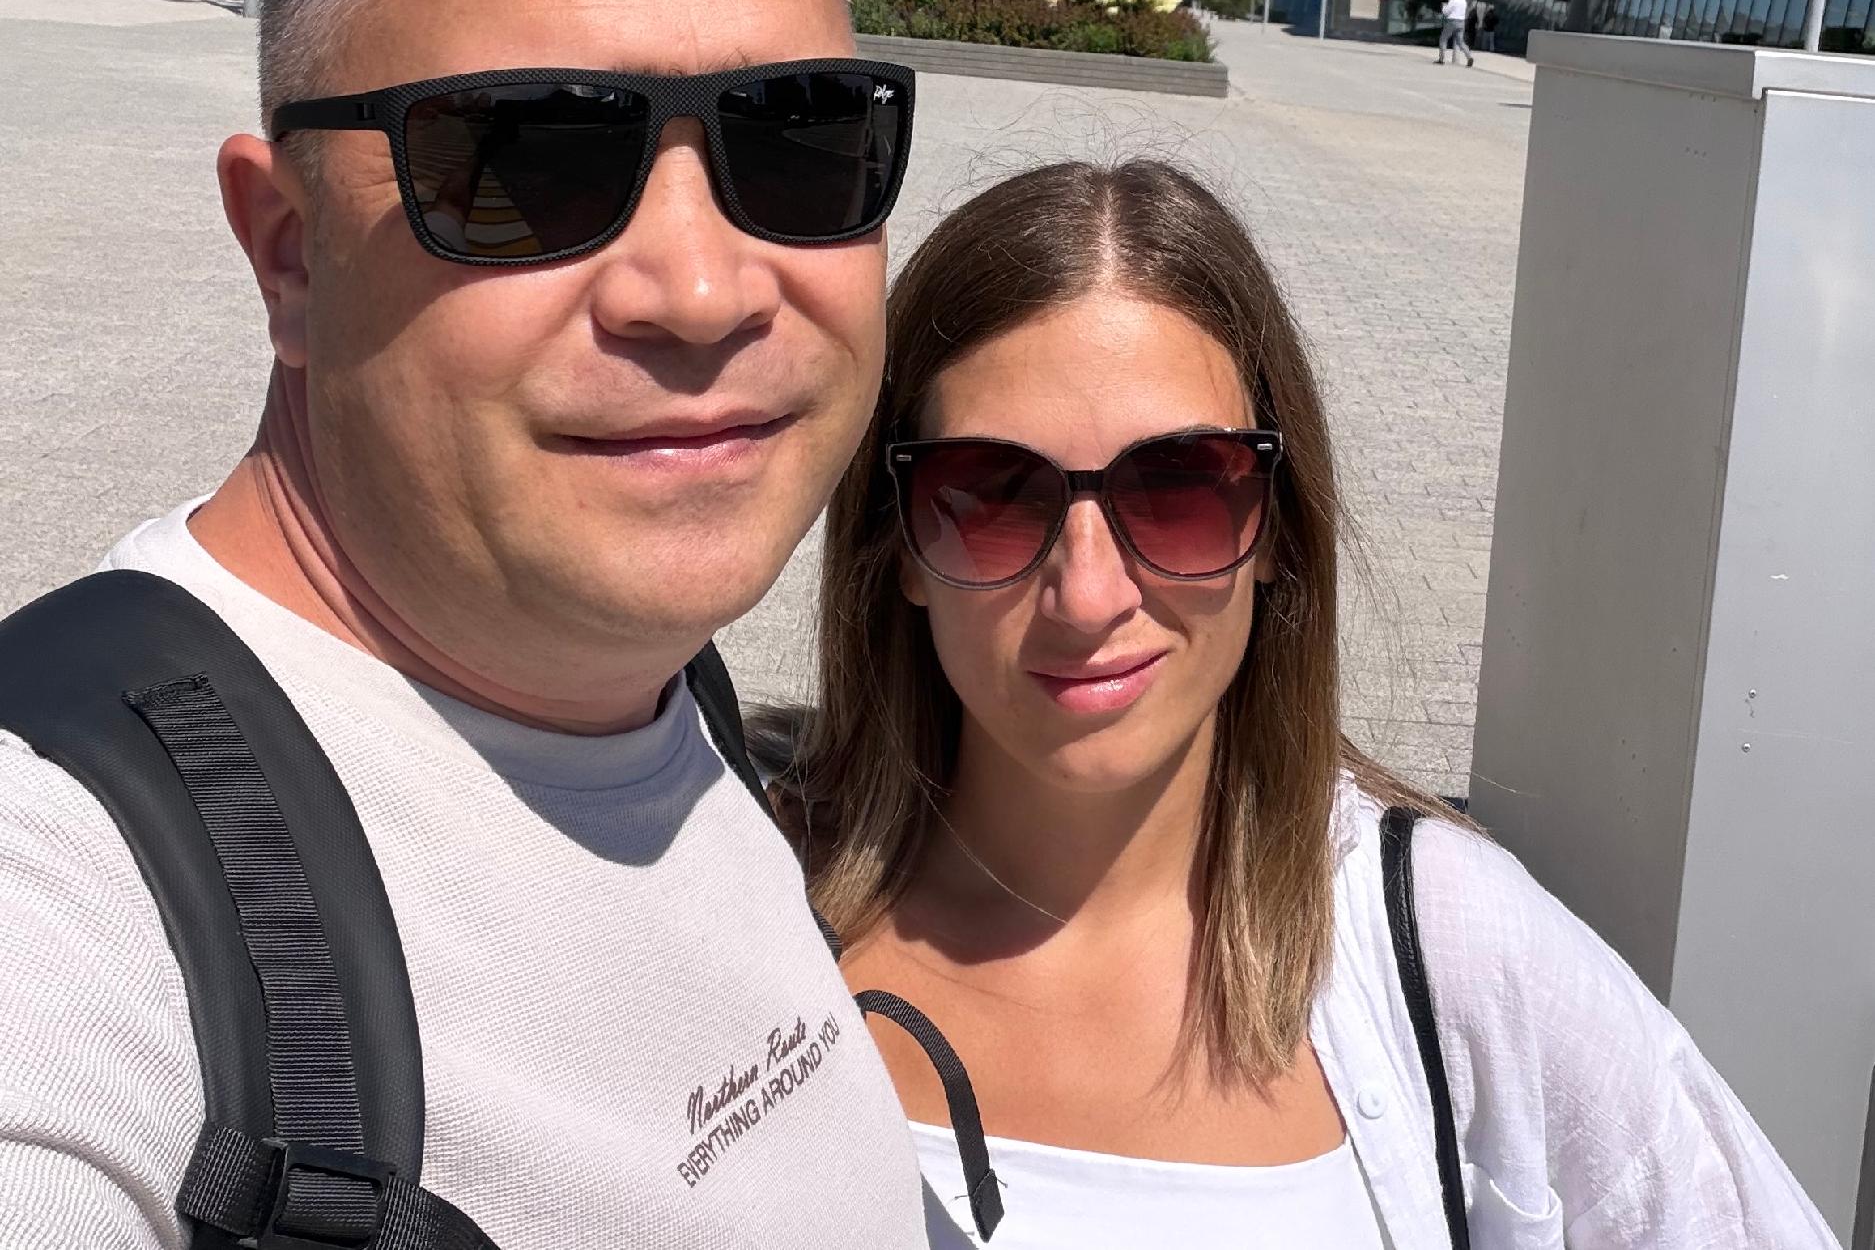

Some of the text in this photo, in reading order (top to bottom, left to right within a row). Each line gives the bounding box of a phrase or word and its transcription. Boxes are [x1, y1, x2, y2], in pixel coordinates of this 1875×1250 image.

[677, 1011, 840, 1188] EVERYTHING AROUND YOU
[687, 1064, 758, 1136] Northern
